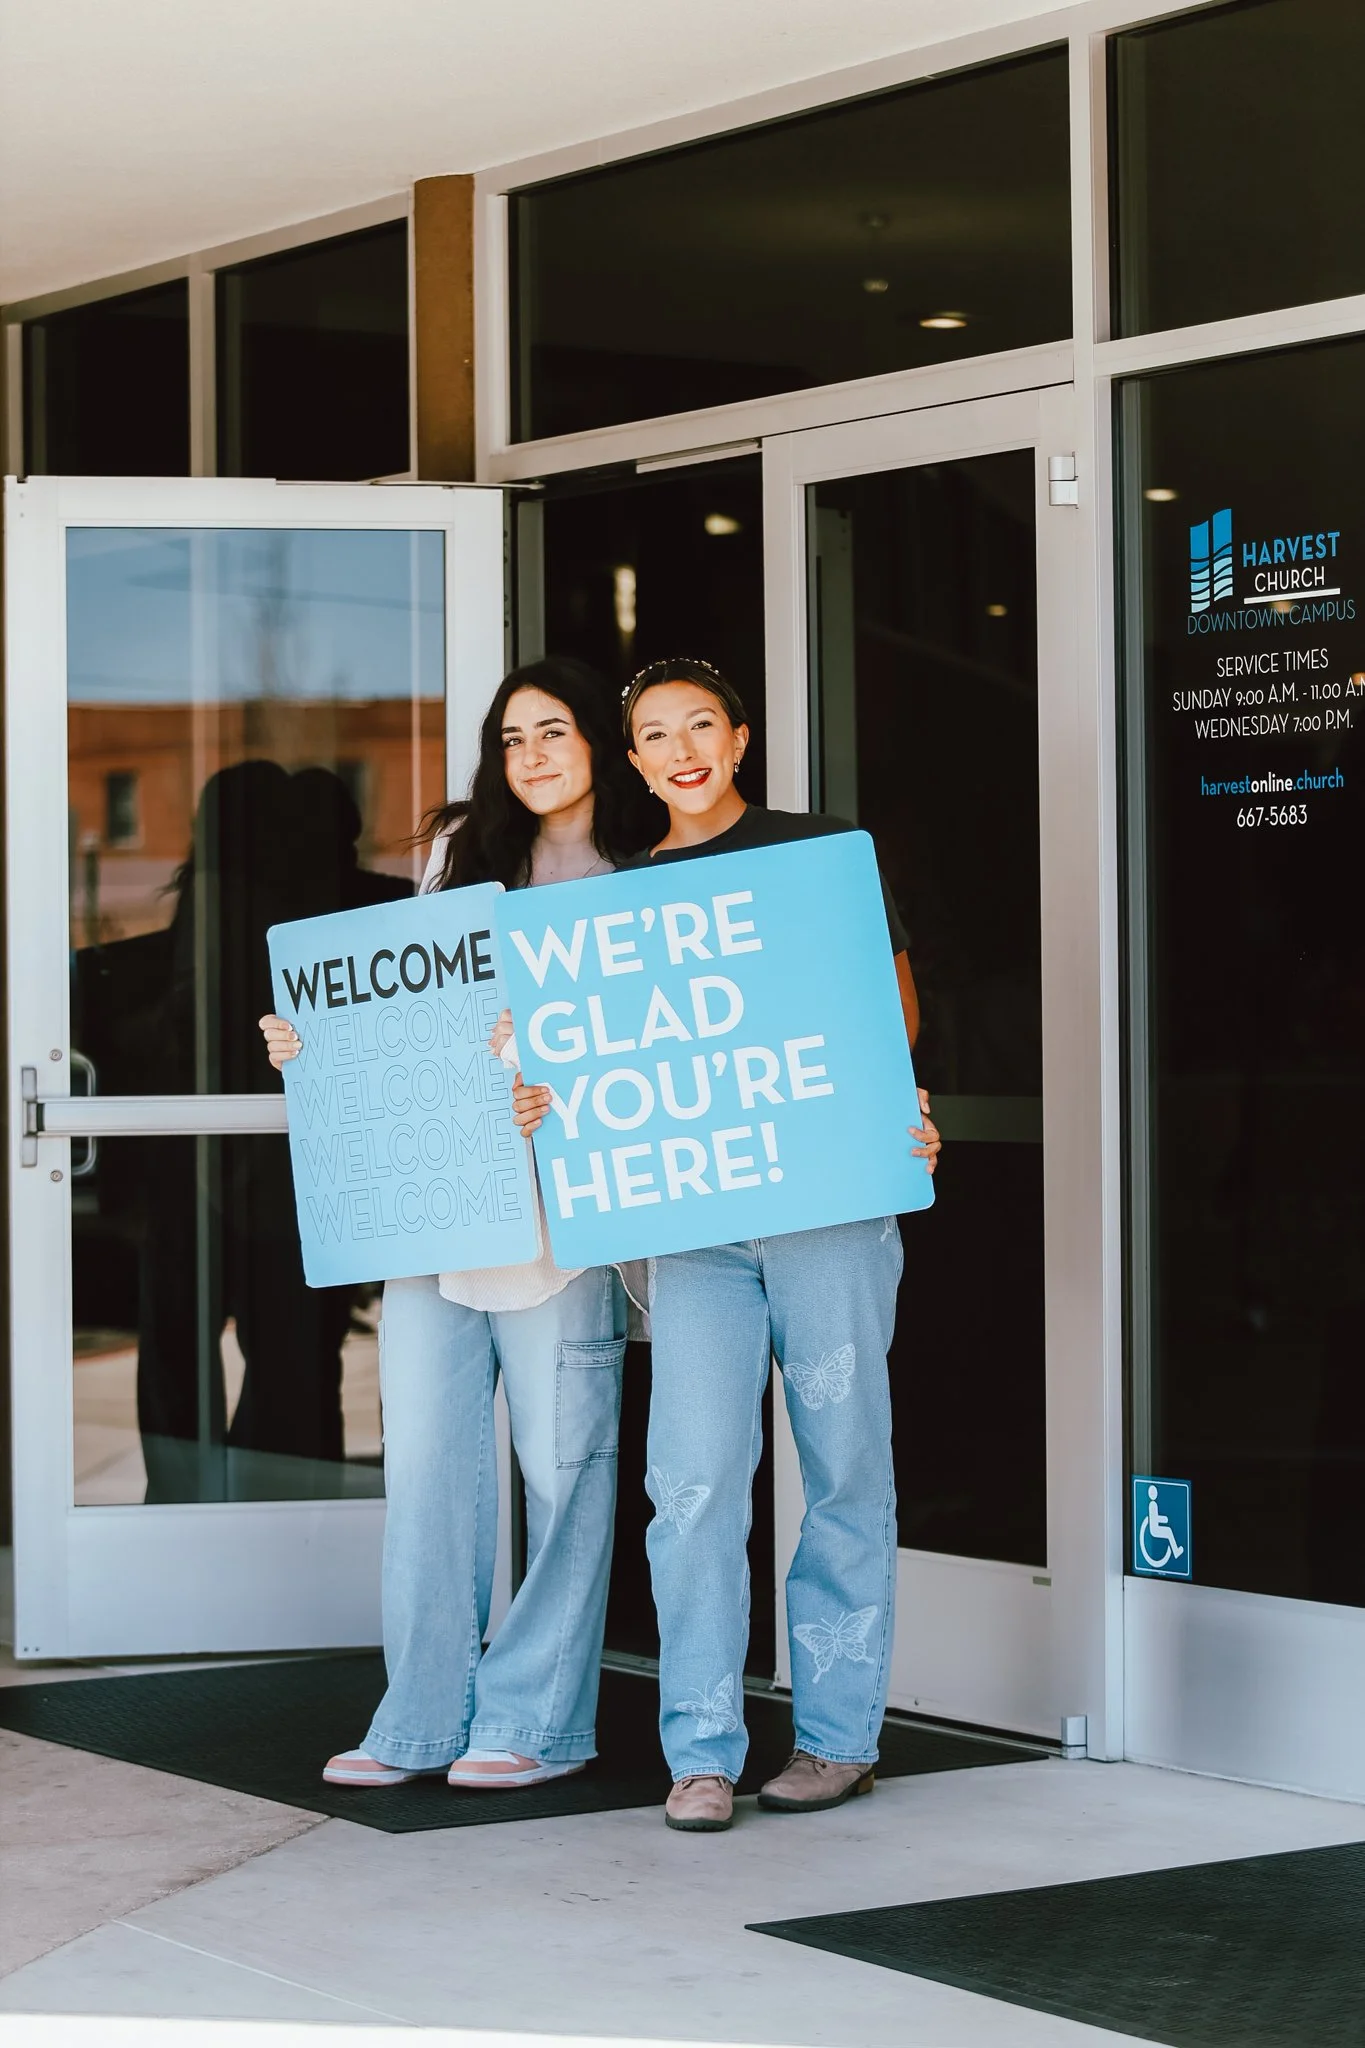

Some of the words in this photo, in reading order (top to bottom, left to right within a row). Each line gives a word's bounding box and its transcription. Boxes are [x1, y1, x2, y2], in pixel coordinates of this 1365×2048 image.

[1242, 531, 1341, 568] HARVEST
[1254, 566, 1326, 593] CHURCH
[1187, 607, 1285, 635] DOWNTOWN
[1289, 599, 1356, 625] CAMPUS
[1172, 687, 1232, 711] SUNDAY
[1235, 690, 1264, 706] 9:00
[1268, 682, 1299, 704] A.M.
[1216, 652, 1280, 678] SERVICE
[1283, 648, 1329, 672] TIMES
[1194, 713, 1290, 739] WEDNESDAY
[1293, 715, 1321, 732] 7:00
[1325, 708, 1354, 730] P.M.
[1201, 767, 1345, 796] harvestonline.church
[1236, 804, 1308, 828] 667-5683
[281, 929, 496, 1015] WELCOME
[508, 890, 763, 989] WE'RE
[297, 988, 498, 1073] WELCOME
[527, 975, 745, 1064] GLAD
[294, 1049, 509, 1130] WELCOME
[534, 1034, 835, 1140] YOU'RE
[300, 1107, 516, 1188] WELCOME
[551, 1121, 785, 1219] HERE!
[306, 1167, 522, 1246] WELCOME
